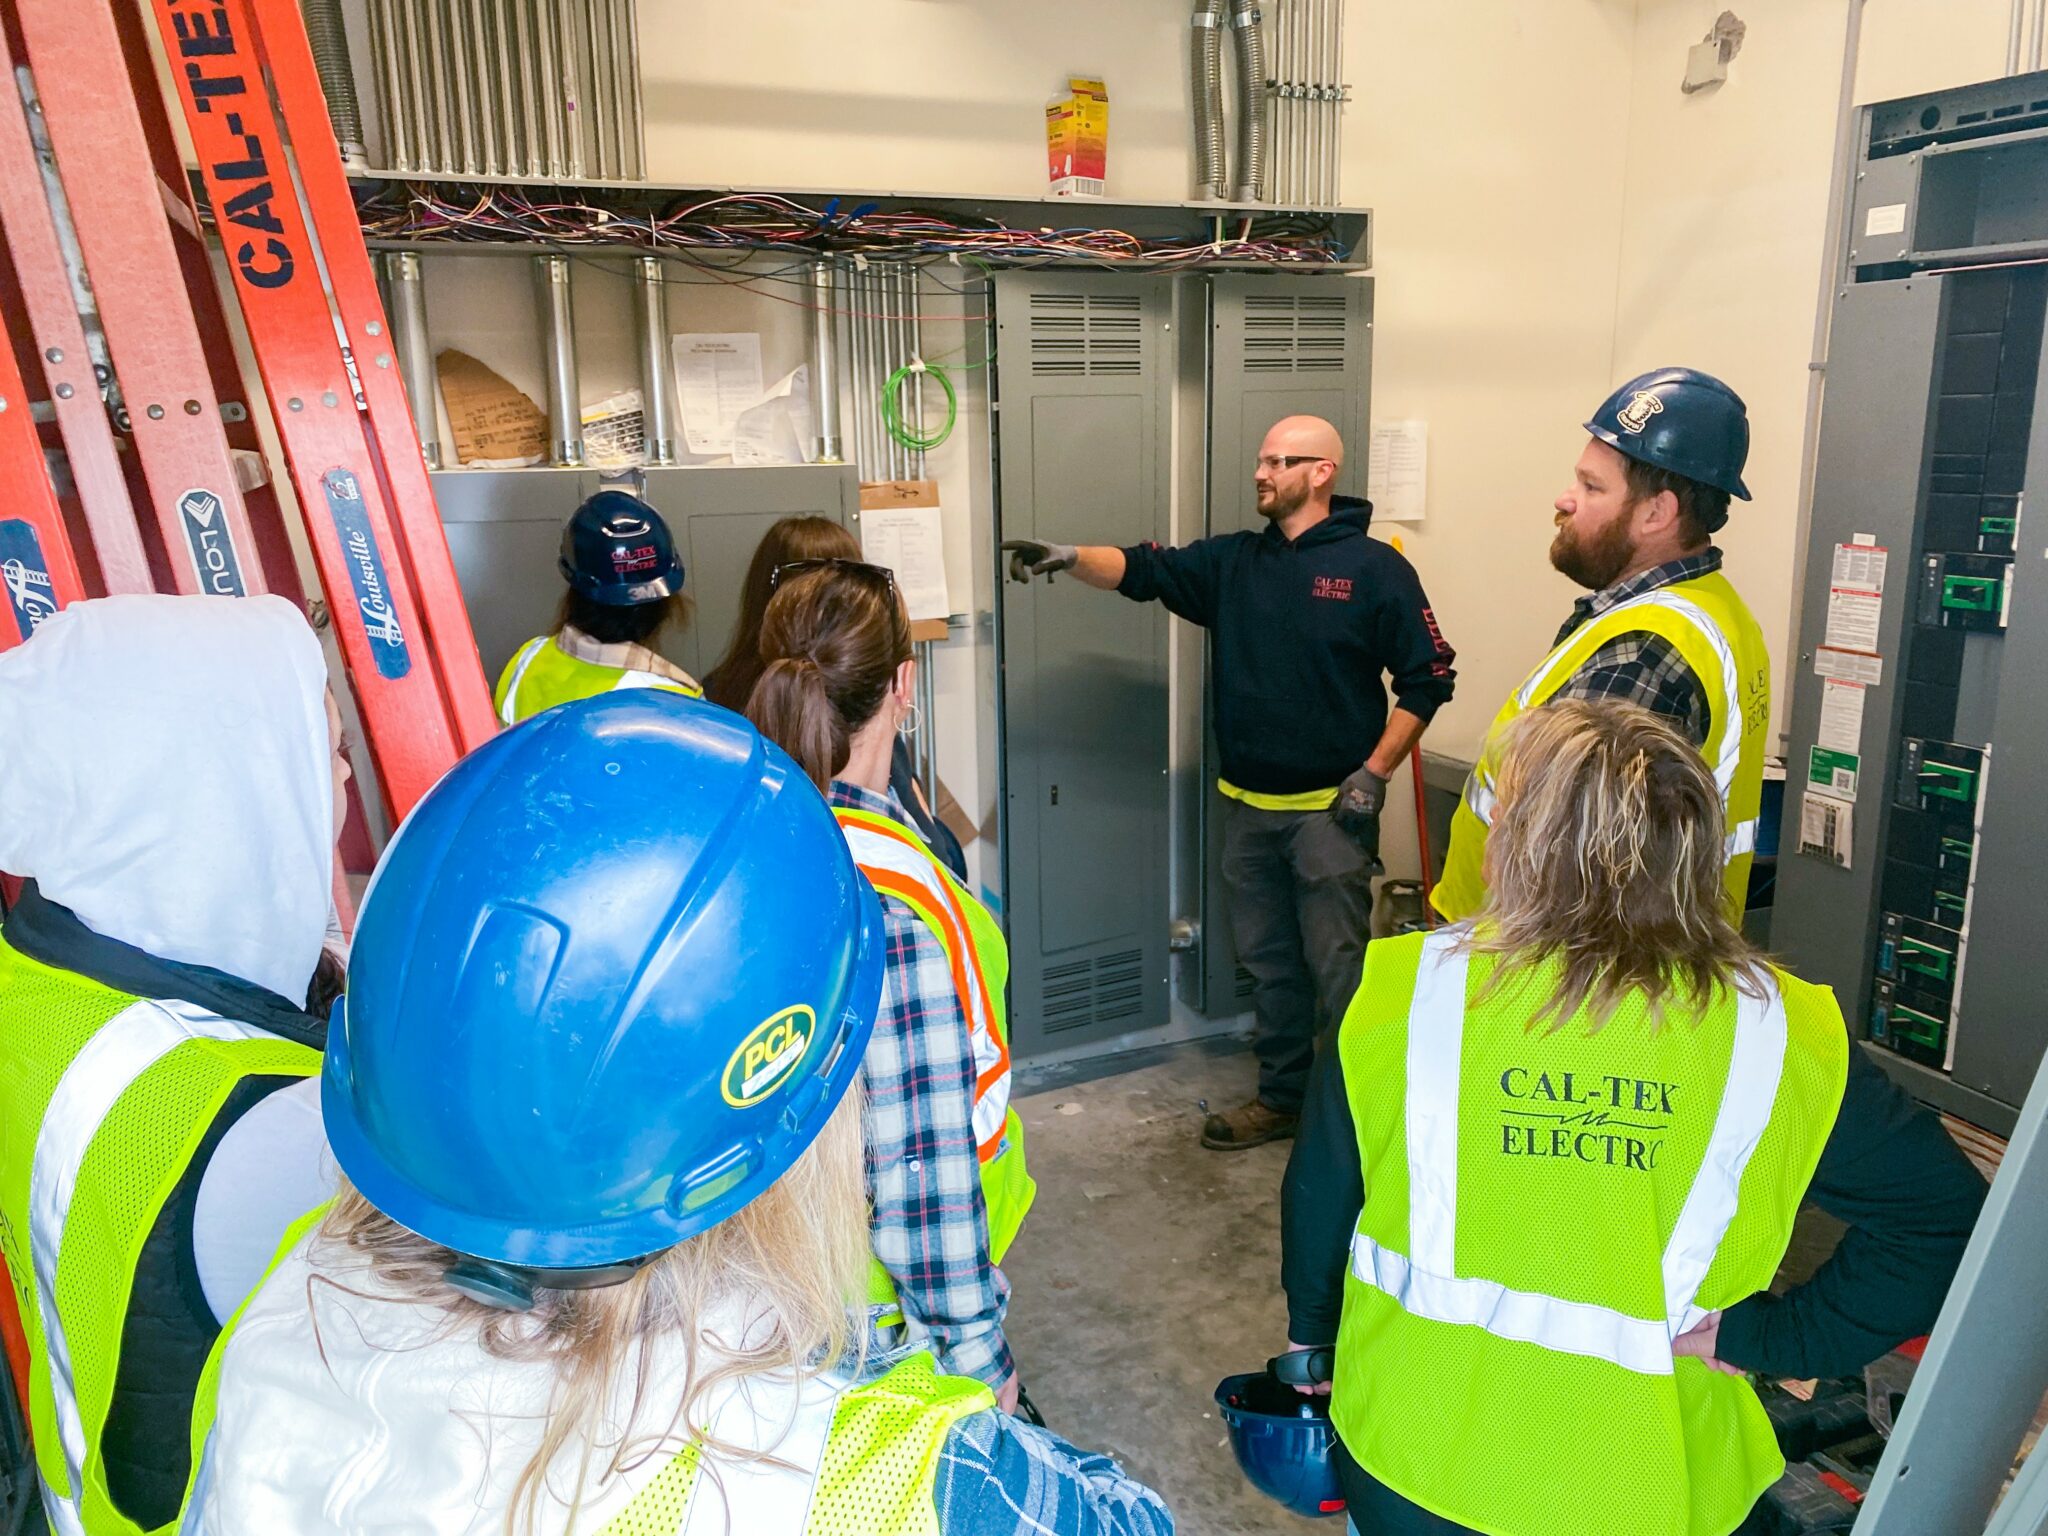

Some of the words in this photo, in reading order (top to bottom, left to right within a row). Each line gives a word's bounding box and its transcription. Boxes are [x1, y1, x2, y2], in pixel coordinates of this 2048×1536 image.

[167, 0, 295, 289] CAL-TE
[200, 530, 237, 598] LOU
[350, 530, 404, 648] Louisville
[1314, 576, 1353, 591] CAL-TEX
[744, 1015, 801, 1080] PCL
